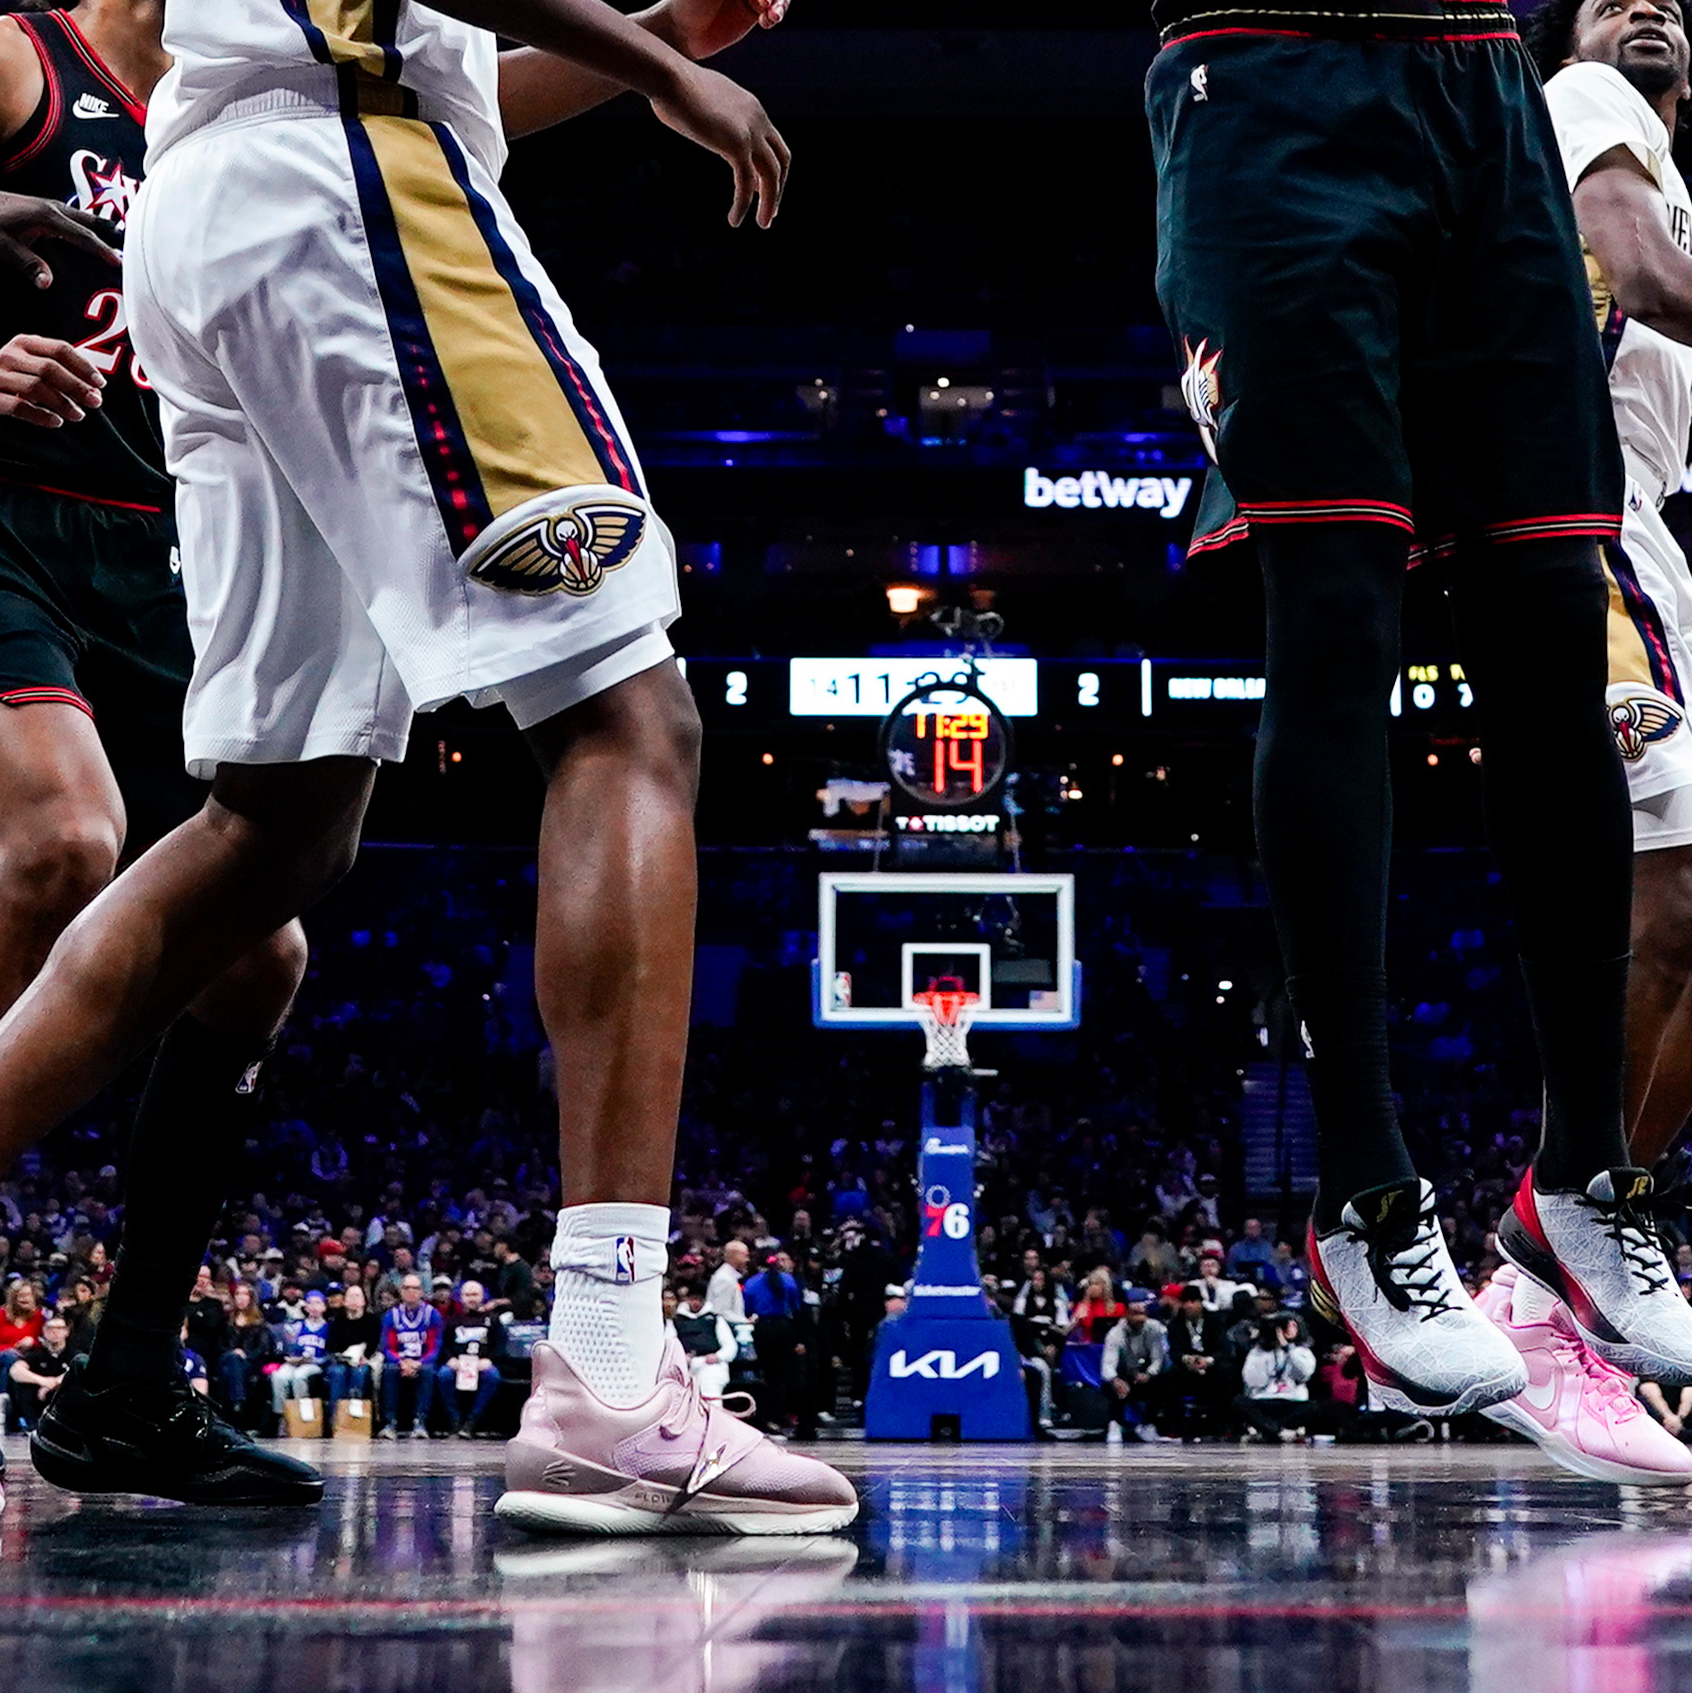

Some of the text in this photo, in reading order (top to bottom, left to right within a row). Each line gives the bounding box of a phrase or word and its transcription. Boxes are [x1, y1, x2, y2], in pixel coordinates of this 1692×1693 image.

[81, 92, 110, 113] NIKE
[1024, 467, 1192, 518] betway
[725, 671, 748, 705] 2
[1077, 672, 1100, 706] 2
[1413, 683, 1435, 709] 0
[917, 711, 990, 740] 11:29
[935, 738, 984, 794] 14
[924, 814, 1000, 832] TISSOT
[925, 1202, 971, 1240] 76
